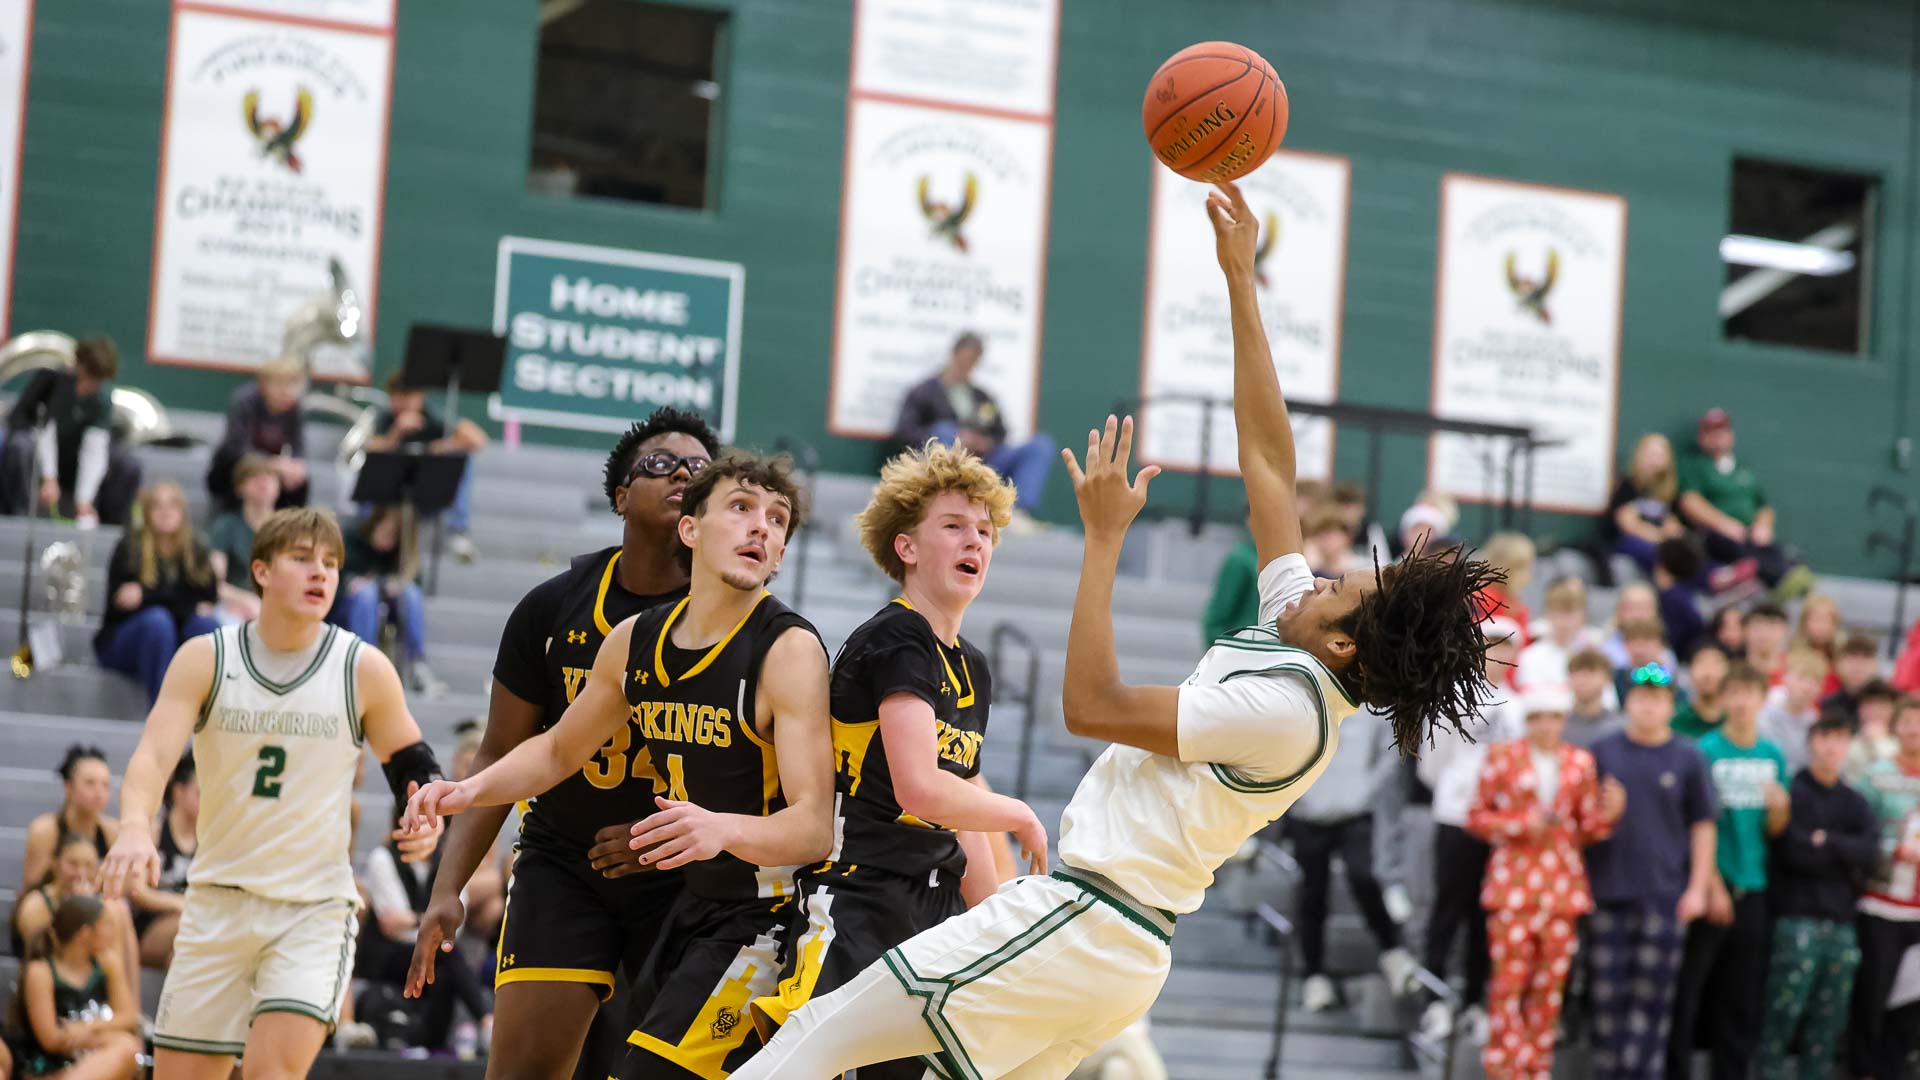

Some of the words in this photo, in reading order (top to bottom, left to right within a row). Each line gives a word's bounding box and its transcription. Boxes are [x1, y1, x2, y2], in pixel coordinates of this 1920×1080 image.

[552, 274, 690, 326] HOME
[511, 312, 723, 367] STUDENT
[515, 353, 713, 409] SECTION
[251, 745, 287, 798] 2
